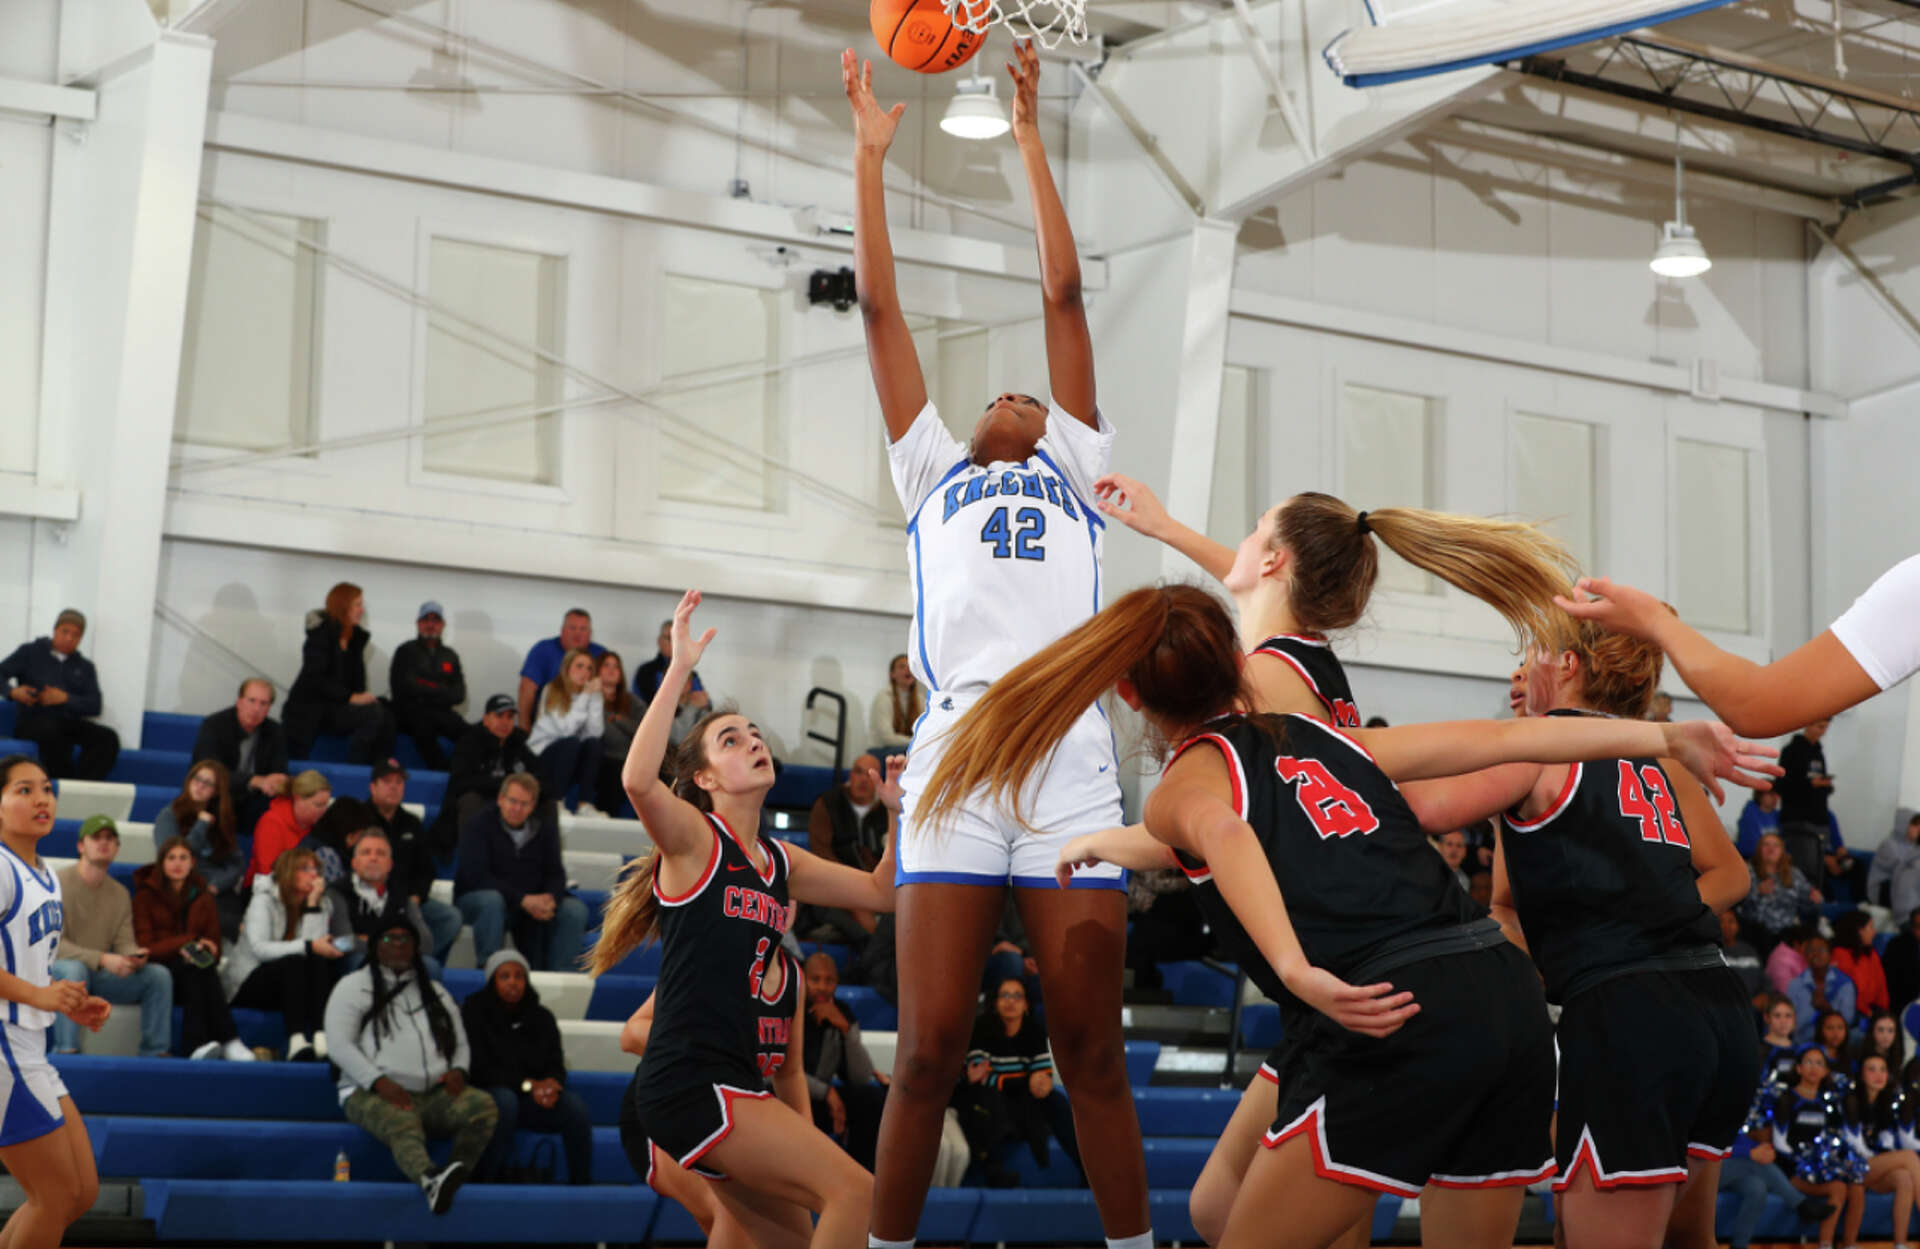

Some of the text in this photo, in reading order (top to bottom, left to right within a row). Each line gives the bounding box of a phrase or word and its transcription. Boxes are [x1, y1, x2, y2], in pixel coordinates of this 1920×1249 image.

[981, 506, 1046, 562] 42
[1618, 759, 1690, 849] 42
[723, 885, 787, 934] CENTR
[757, 1016, 792, 1044] NTRA
